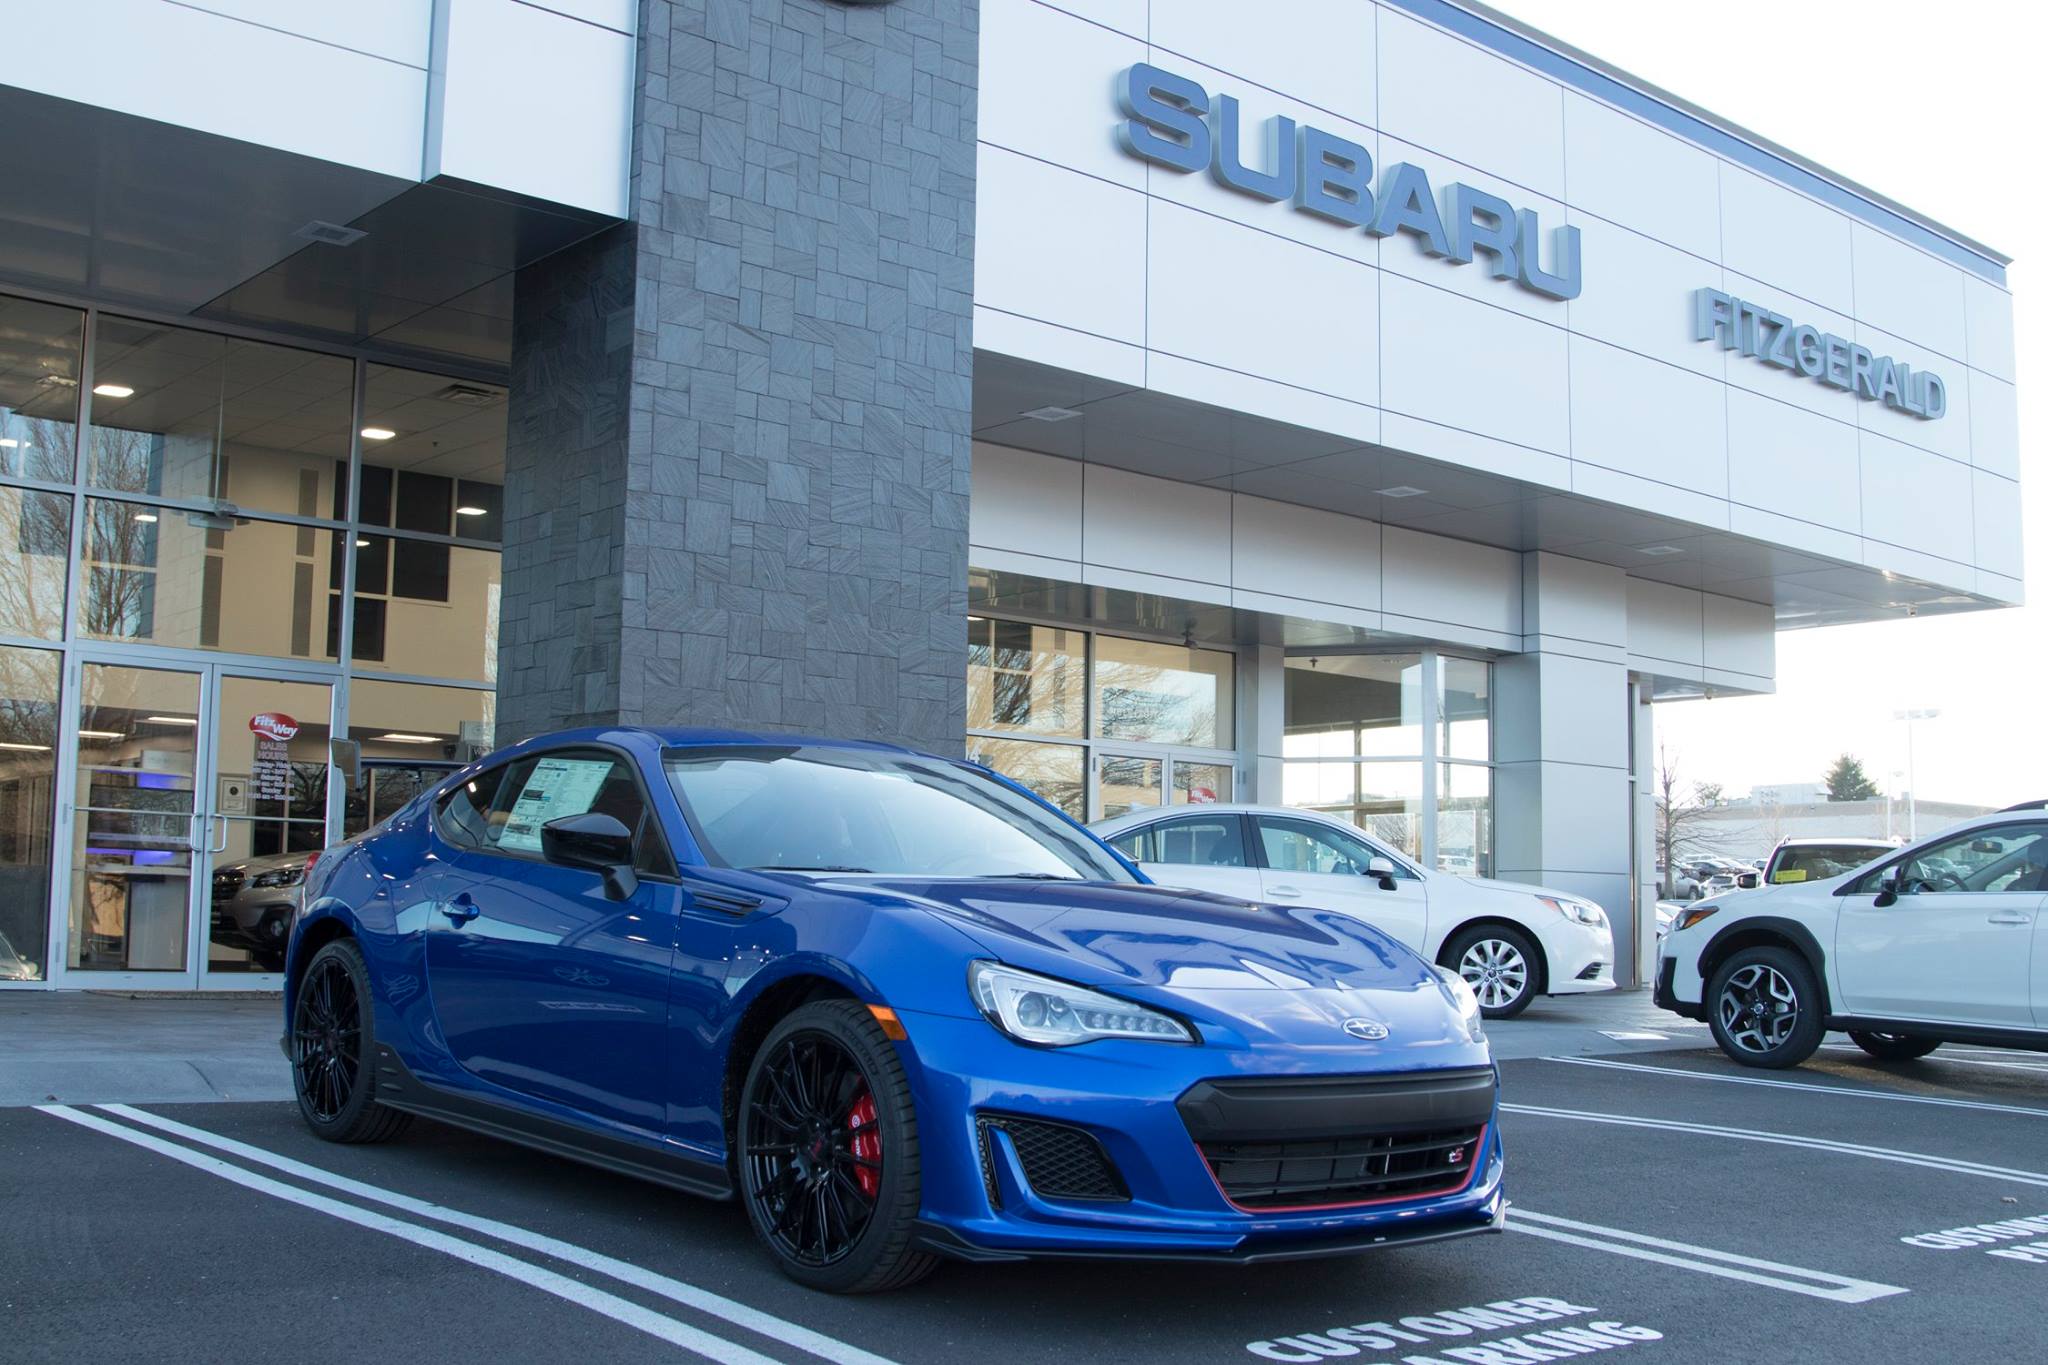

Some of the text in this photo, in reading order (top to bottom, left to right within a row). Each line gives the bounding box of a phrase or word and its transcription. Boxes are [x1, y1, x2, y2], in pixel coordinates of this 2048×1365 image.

[1116, 62, 1582, 301] SUBARU
[1696, 287, 1947, 421] FITZGERALD
[273, 723, 298, 737] Way
[1900, 1214, 2048, 1249] CUSTOM
[1246, 1296, 1599, 1362] CUSTOMER
